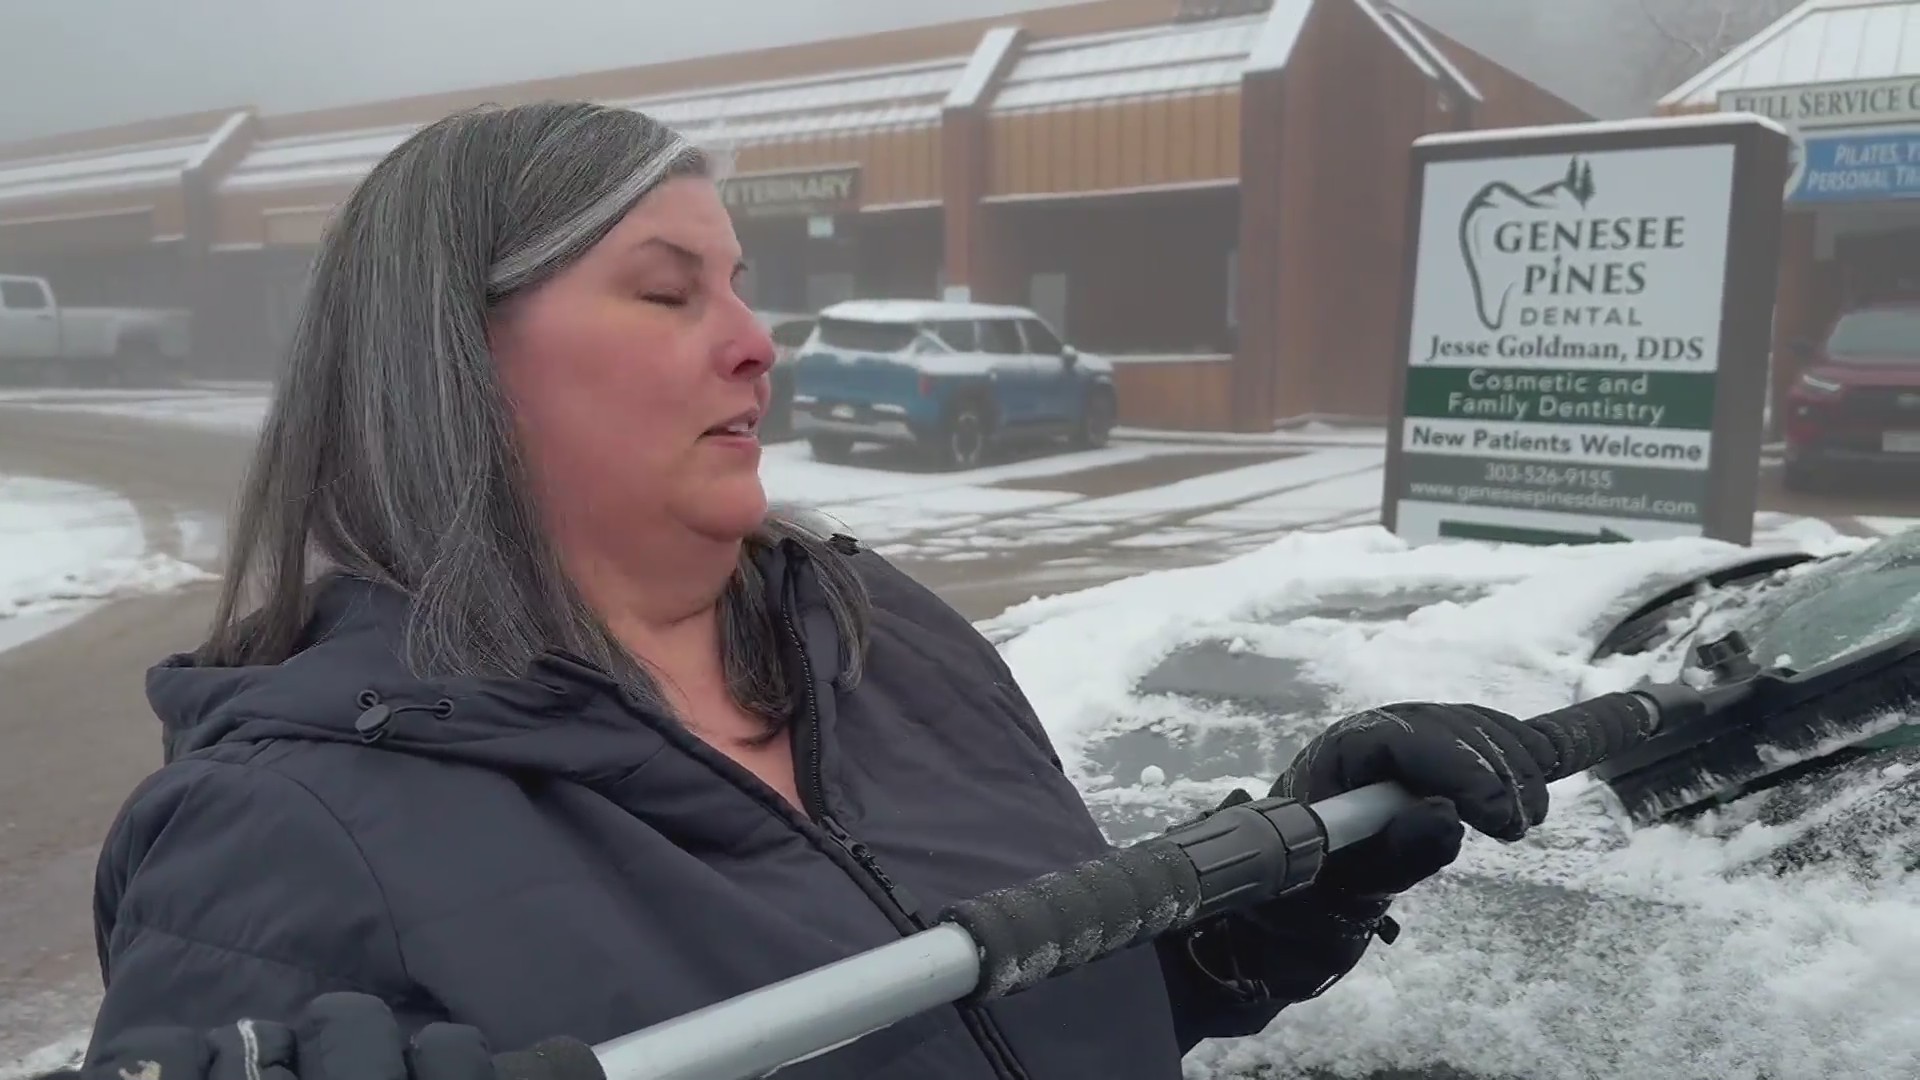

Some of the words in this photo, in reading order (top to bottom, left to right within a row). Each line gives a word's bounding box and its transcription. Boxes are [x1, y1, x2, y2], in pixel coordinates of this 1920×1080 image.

[1798, 84, 1902, 118] SERVICE
[1806, 167, 1890, 192] PERSONAL
[1493, 216, 1686, 254] GENESEE
[1519, 306, 1642, 328] DENTAL
[1427, 334, 1490, 362] Jesse
[1497, 334, 1628, 363] Goldman,
[1635, 336, 1704, 362] DDS
[1468, 369, 1588, 393] Cosmetic
[1598, 373, 1649, 395] and
[1448, 392, 1530, 420] Family
[1538, 394, 1666, 425] Dentistry
[1412, 425, 1466, 448] New
[1472, 429, 1572, 454] Patients
[1580, 433, 1703, 462] Welcome
[1484, 462, 1613, 489] 303-526-9155
[1410, 480, 1697, 515] www.geneseepinesdental.com
